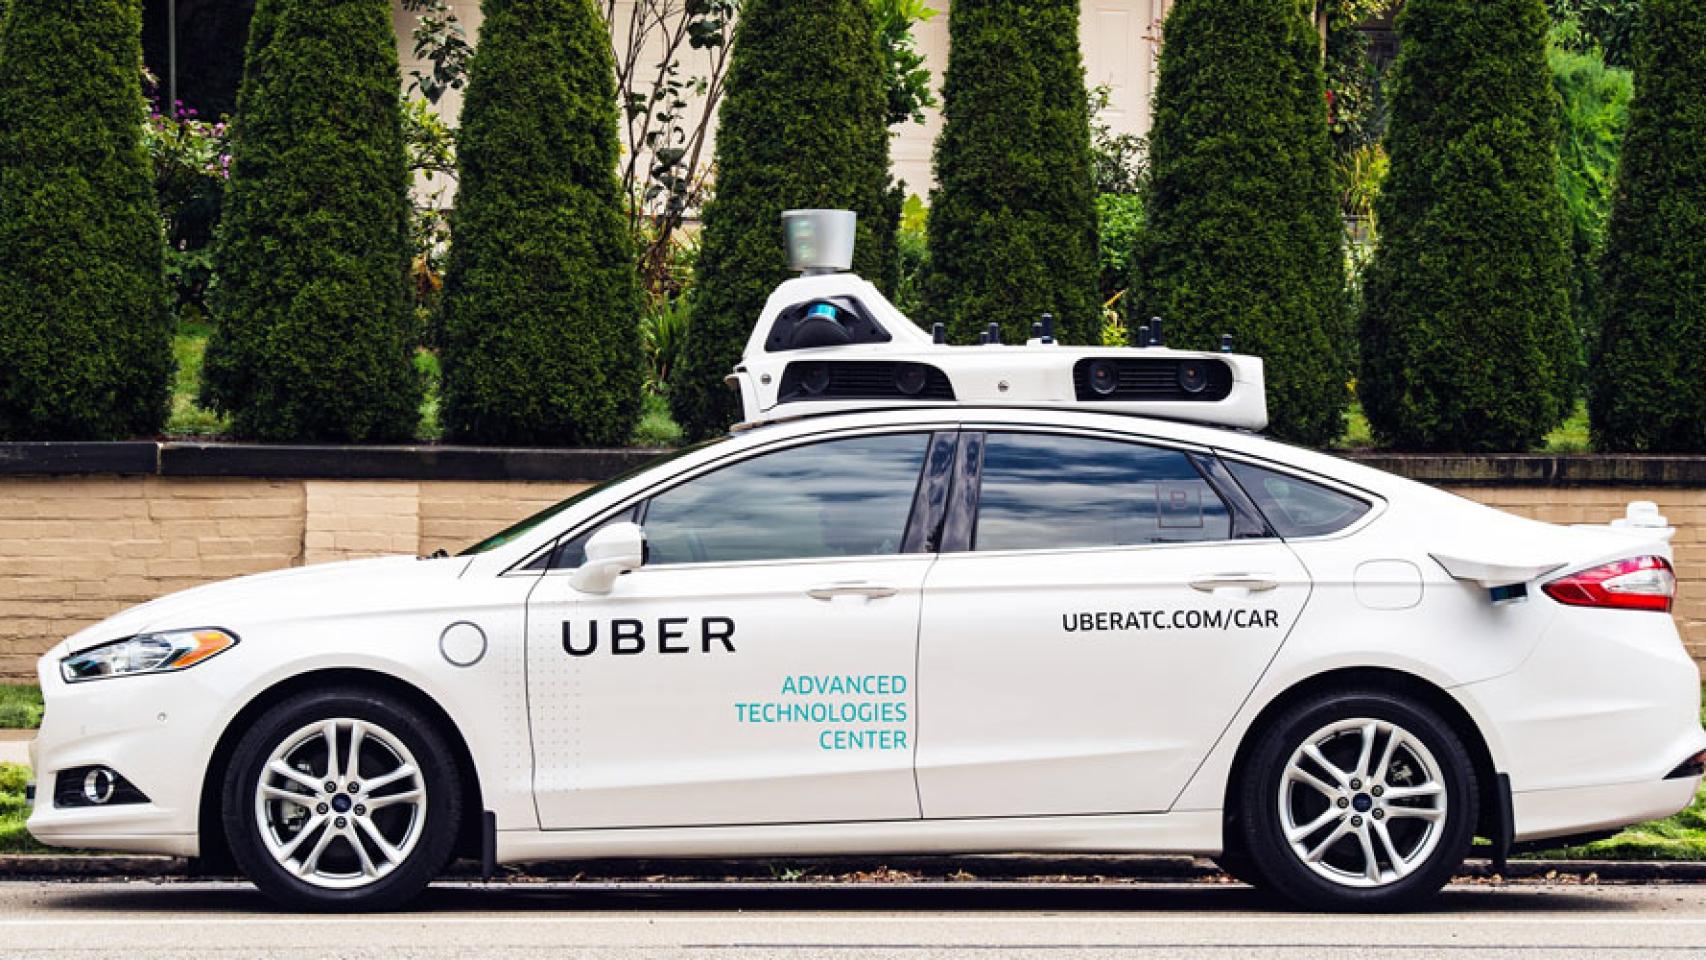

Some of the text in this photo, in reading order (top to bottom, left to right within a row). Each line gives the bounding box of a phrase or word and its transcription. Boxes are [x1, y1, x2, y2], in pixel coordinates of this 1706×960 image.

[1062, 608, 1279, 632] UBERATC.COM/CAR
[561, 616, 736, 657] UBER
[781, 675, 907, 696] ADVANCED
[735, 702, 907, 723] TECHNOLOGIES
[819, 730, 907, 750] CENTER
